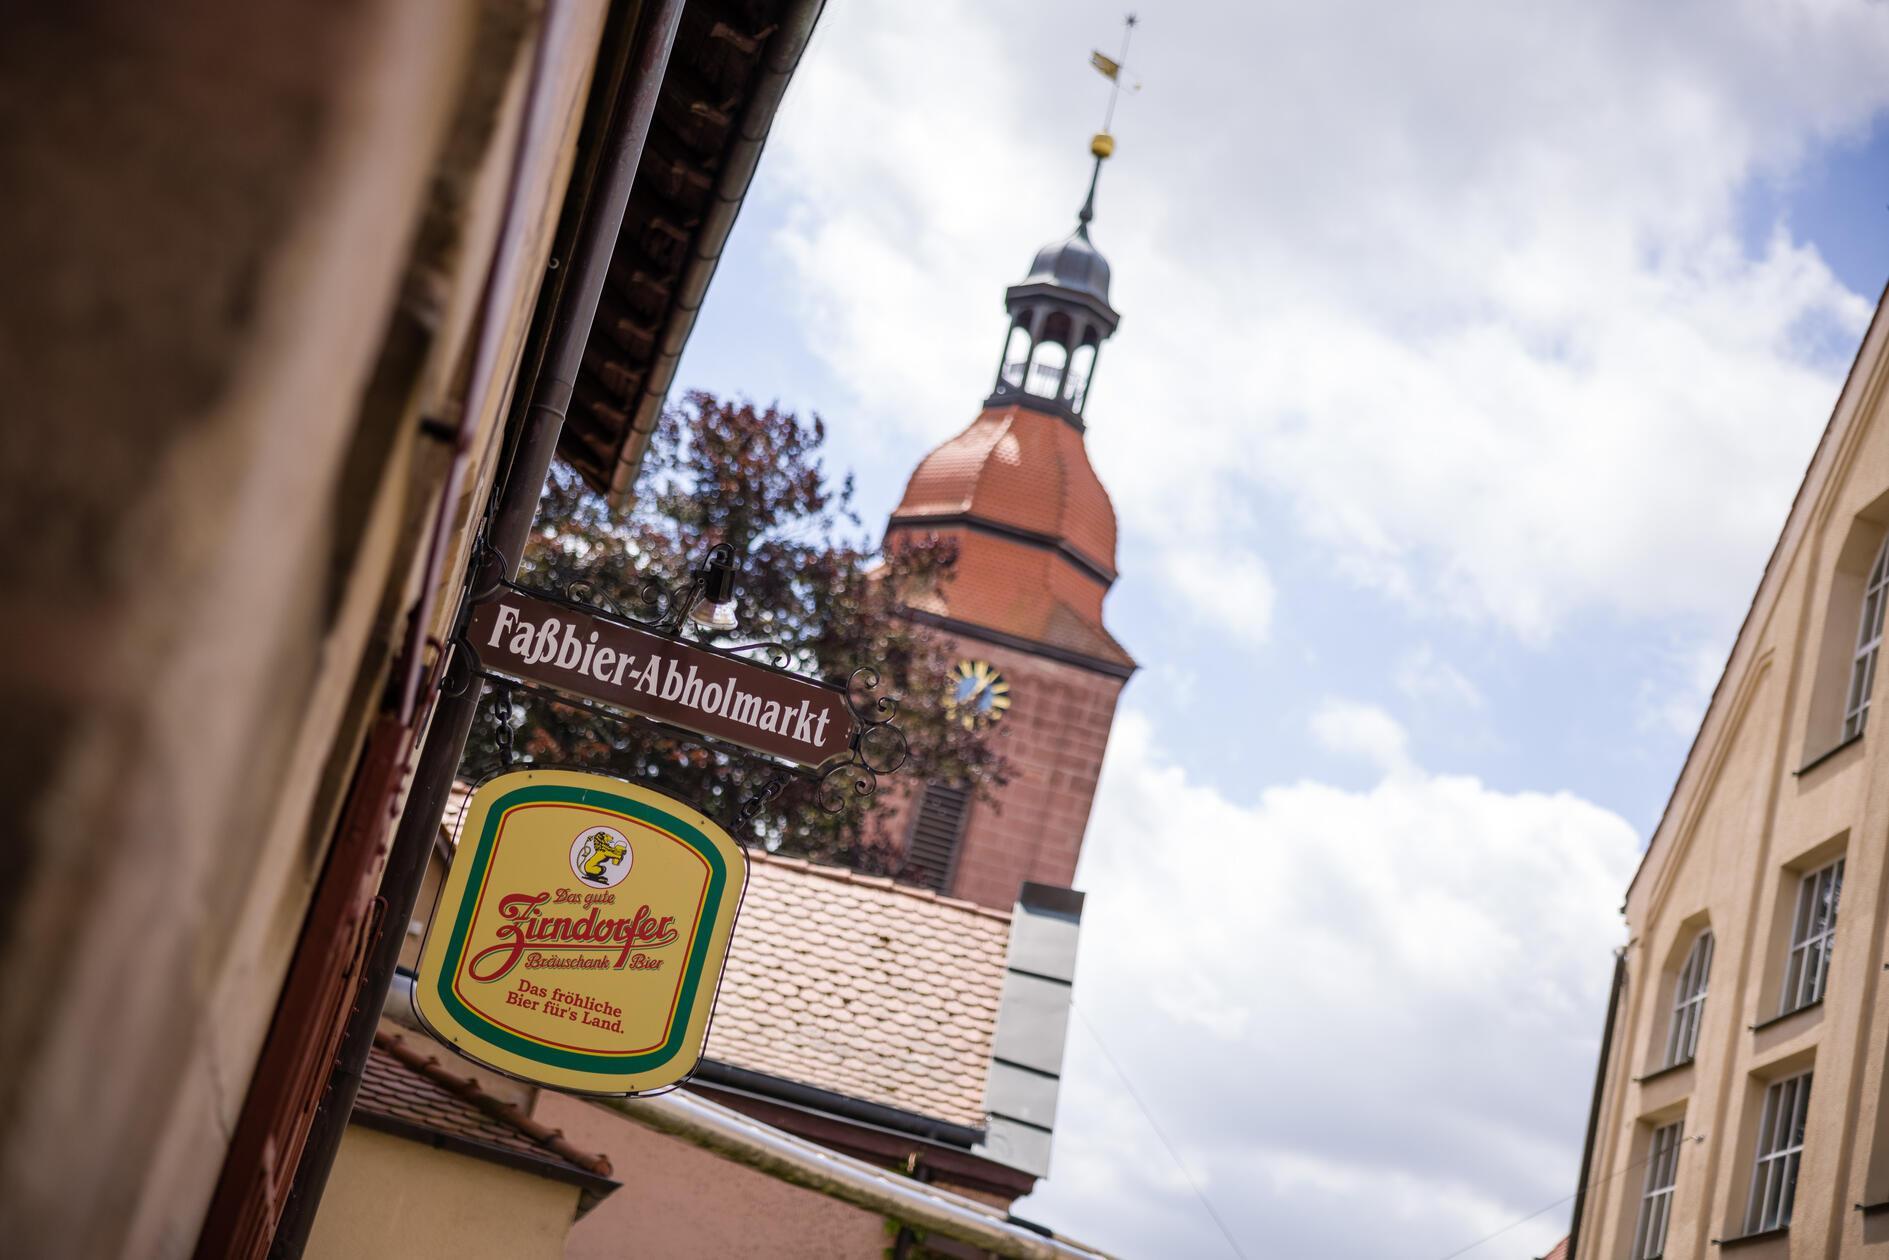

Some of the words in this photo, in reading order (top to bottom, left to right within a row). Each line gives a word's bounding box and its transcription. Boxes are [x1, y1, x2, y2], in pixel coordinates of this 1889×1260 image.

[487, 603, 831, 748] Faßbier-Abholmarkt
[553, 887, 582, 904] Das
[583, 890, 616, 911] gute
[468, 891, 679, 984] Zirndorfer
[524, 951, 611, 971] Bräuschank
[628, 953, 664, 971] Bier
[506, 991, 540, 1012] Bier
[542, 1001, 578, 1022] für's
[581, 1011, 624, 1034] Land.
[517, 979, 548, 998] Das
[550, 988, 622, 1018] fröhliche
